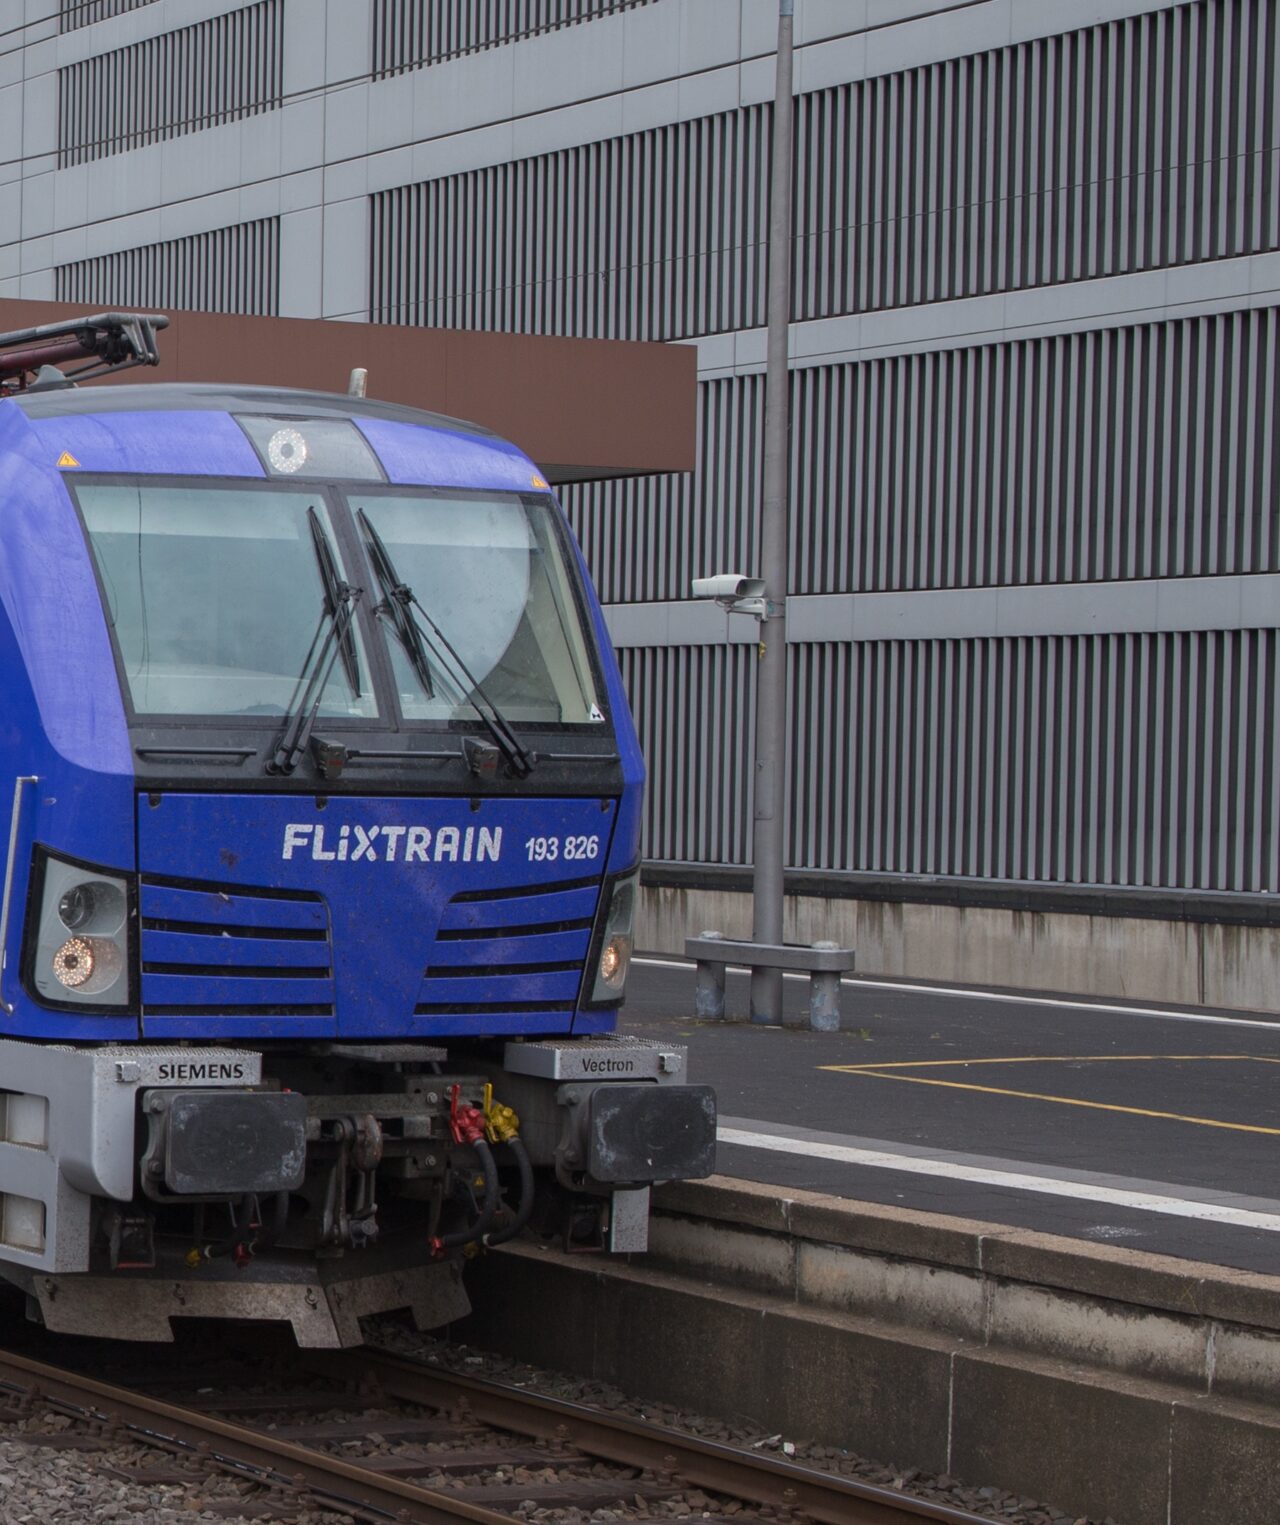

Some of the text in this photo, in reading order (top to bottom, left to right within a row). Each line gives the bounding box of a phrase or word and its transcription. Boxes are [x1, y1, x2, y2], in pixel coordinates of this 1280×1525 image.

[525, 837, 560, 862] 193
[564, 835, 599, 861] 826
[158, 1063, 244, 1081] SIEMENS
[581, 1058, 635, 1074] Vectron
